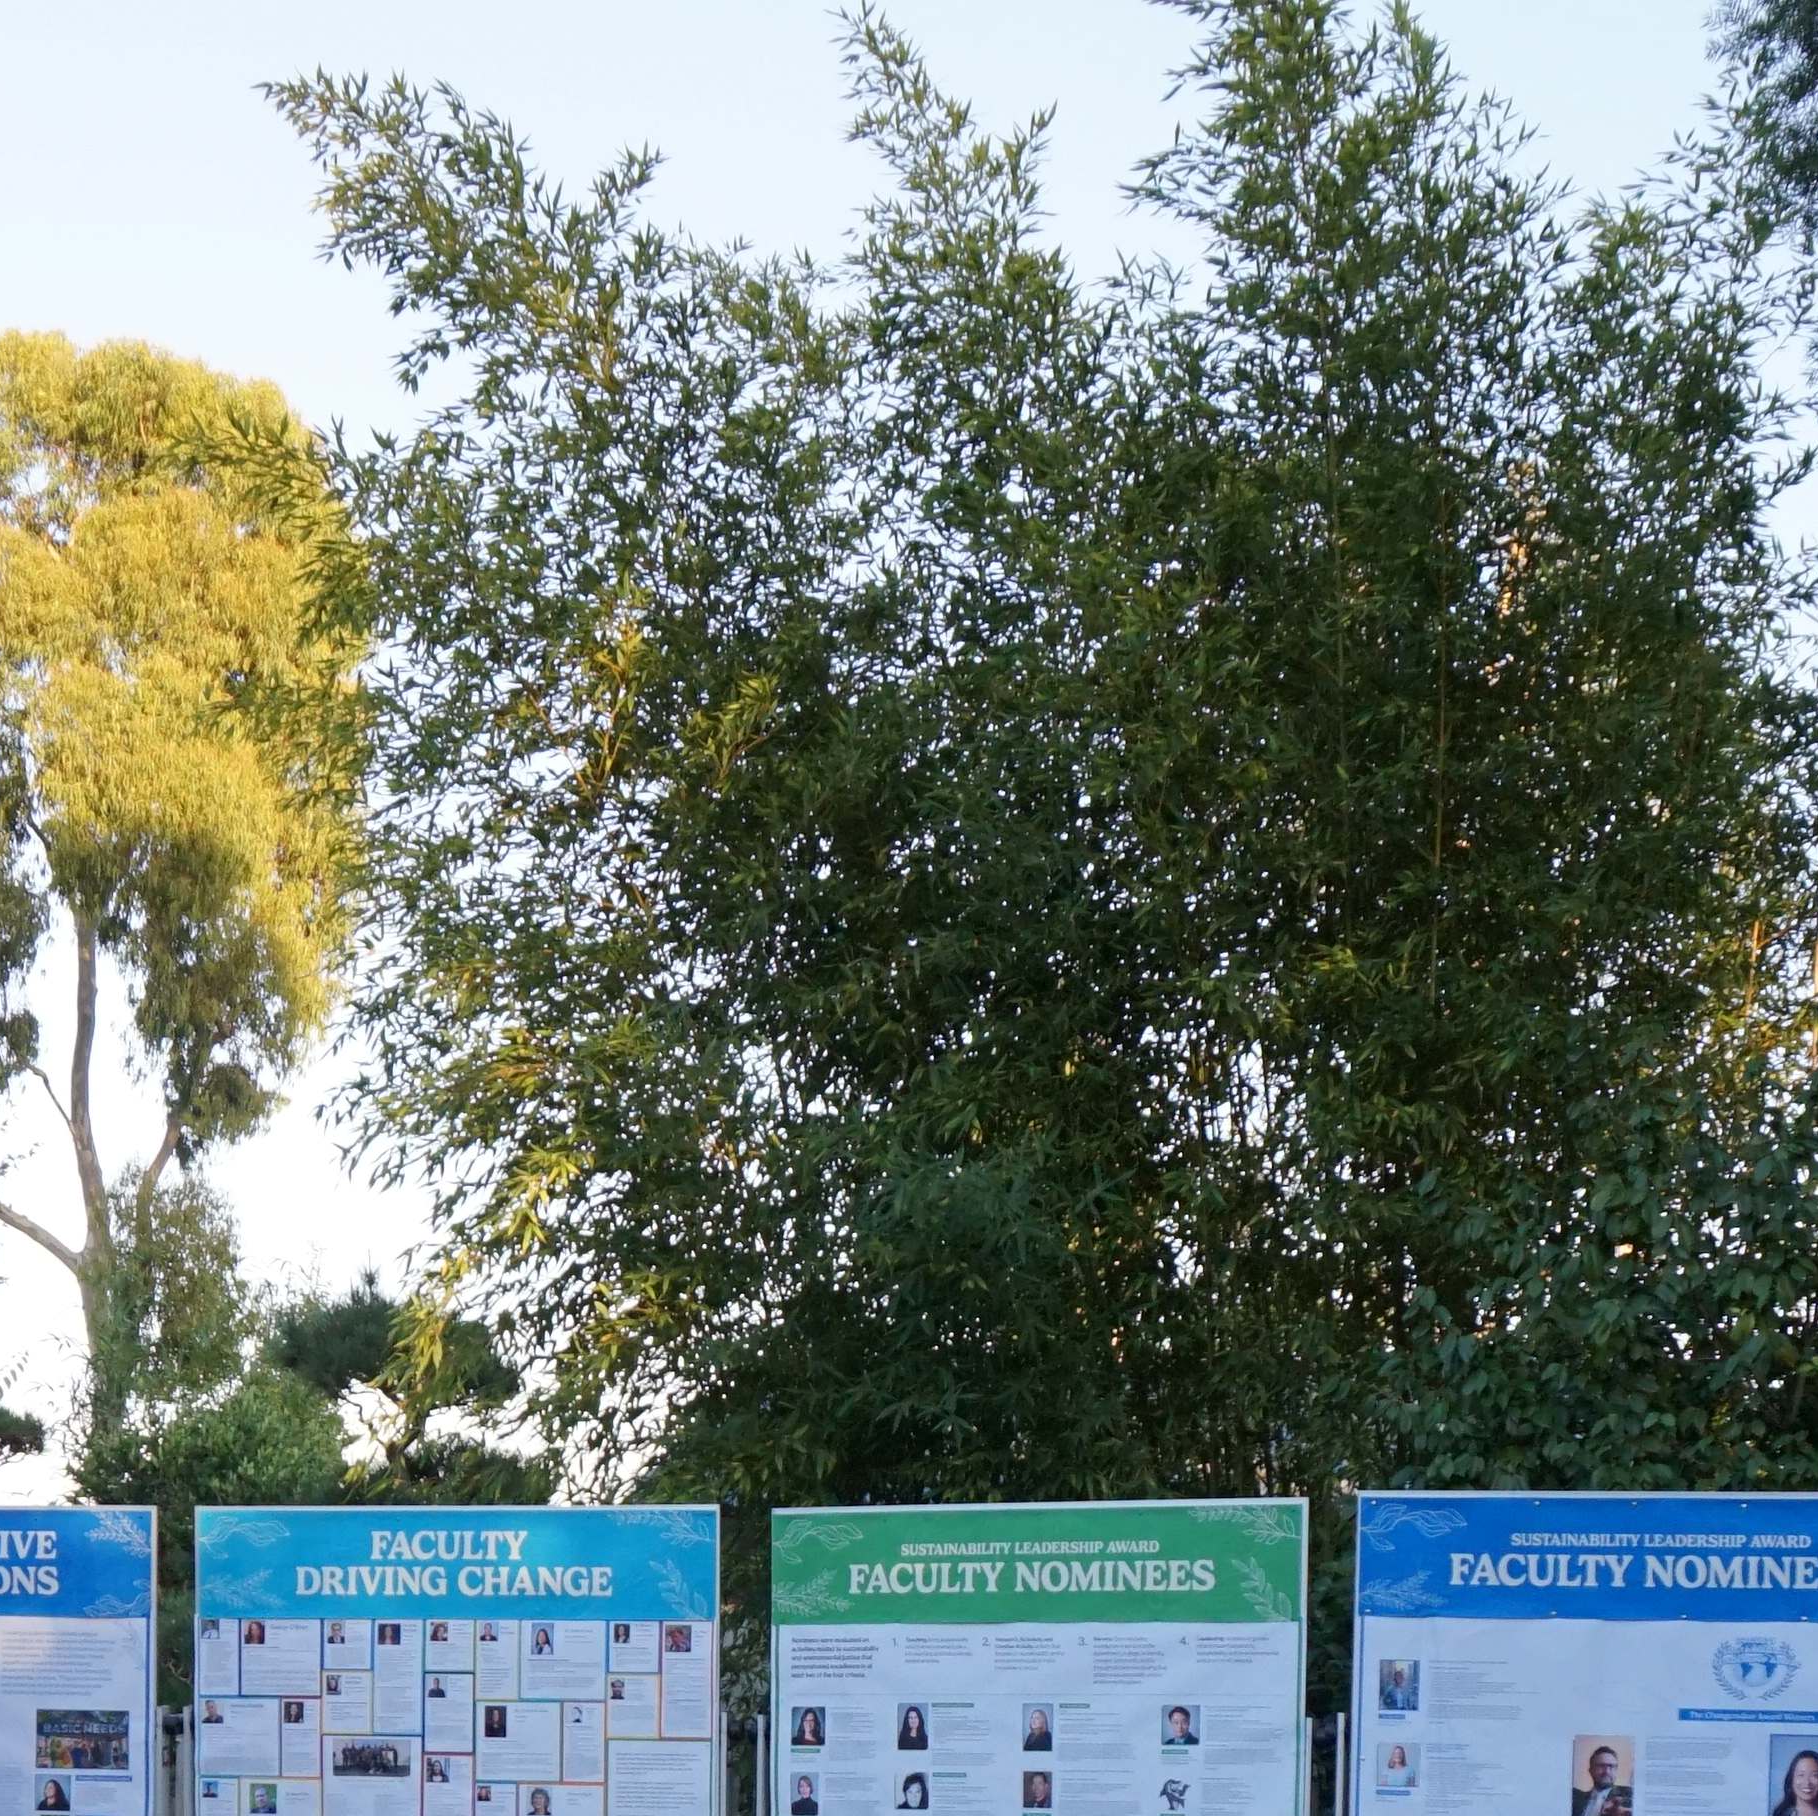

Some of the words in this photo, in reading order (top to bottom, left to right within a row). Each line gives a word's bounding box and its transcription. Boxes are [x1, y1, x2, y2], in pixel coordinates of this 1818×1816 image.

[370, 1530, 529, 1561] FACULTY
[900, 1542, 1012, 1556] SUSTAINABILITY
[1014, 1541, 1104, 1555] LEADERSHIP
[1107, 1540, 1160, 1554] AWARD
[1510, 1532, 1642, 1547] SUSTAINABILITY
[1644, 1533, 1747, 1548] LEADERSHIP
[1751, 1535, 1812, 1549] AWARD
[295, 1566, 448, 1596] DRIVING
[457, 1566, 613, 1597] CHANGE
[848, 1561, 1005, 1595] FACULTY
[1014, 1559, 1216, 1593] NOMINEES
[1448, 1552, 1633, 1588] FACULTY
